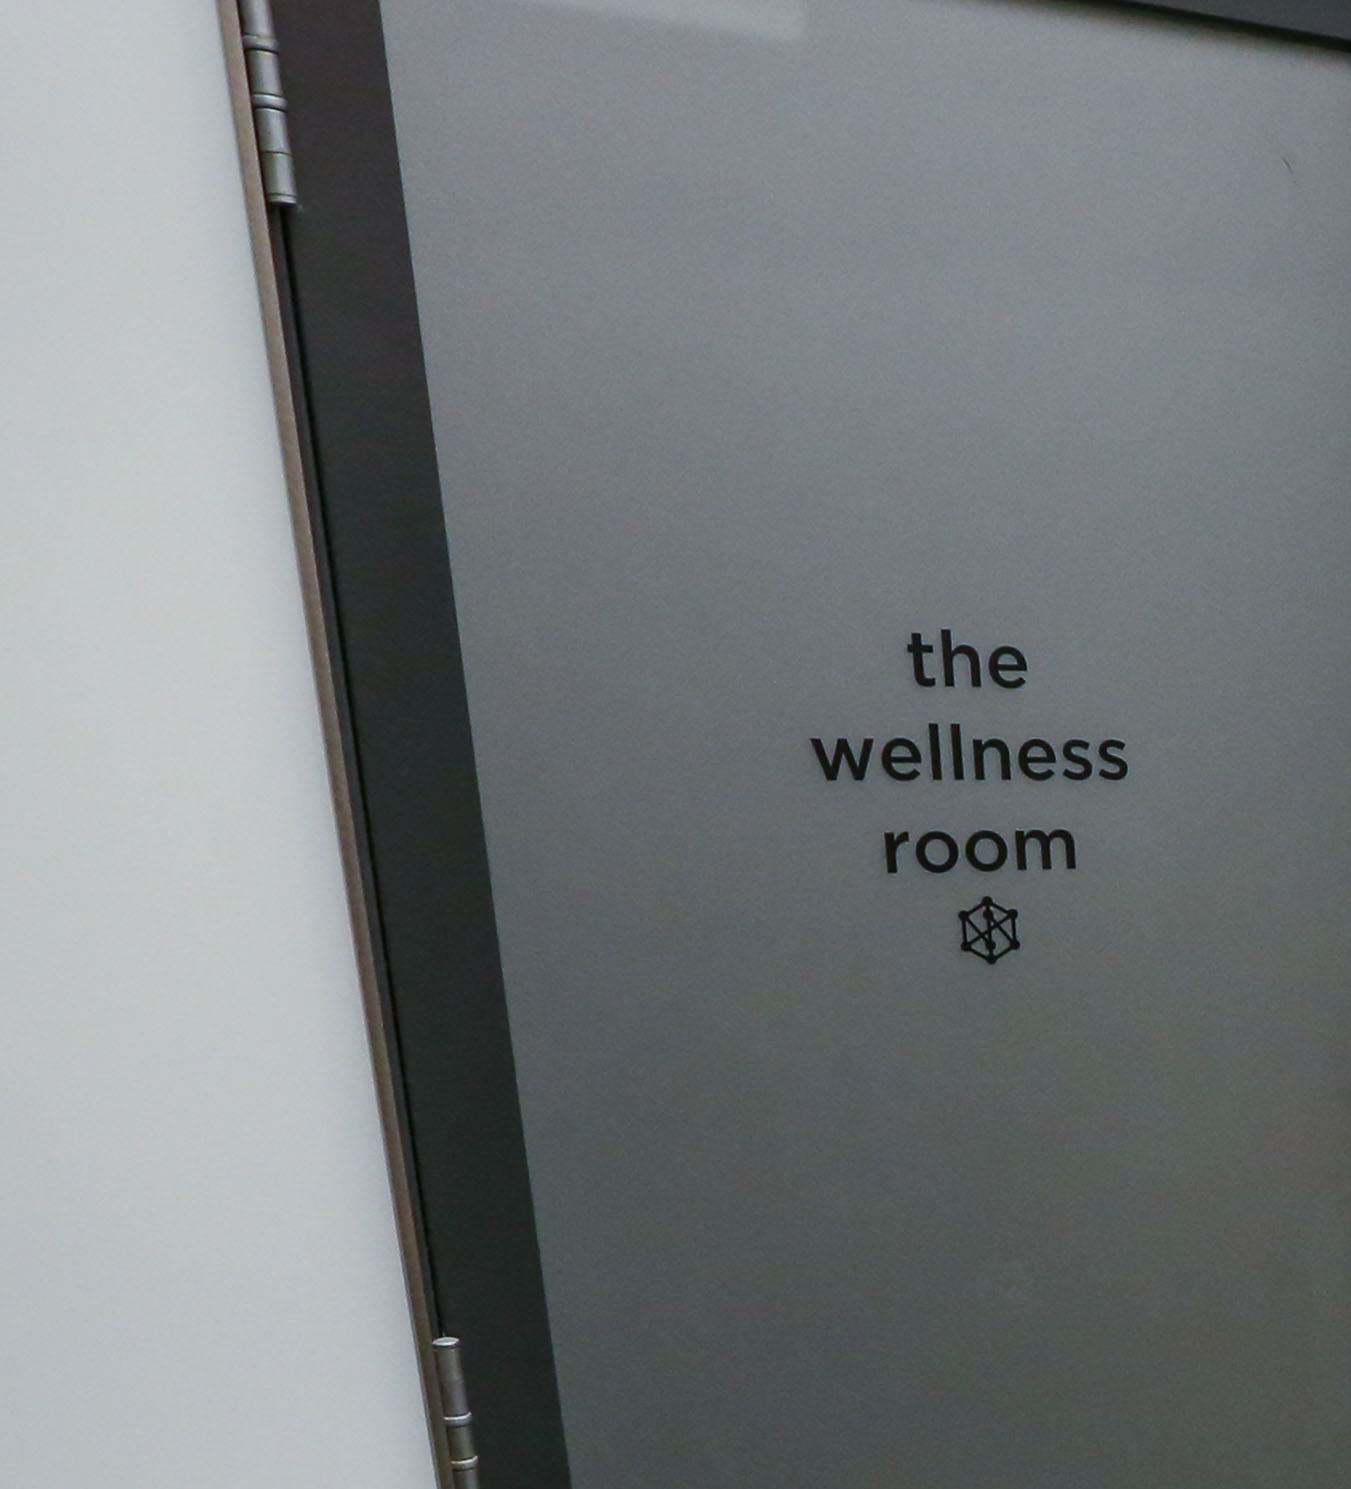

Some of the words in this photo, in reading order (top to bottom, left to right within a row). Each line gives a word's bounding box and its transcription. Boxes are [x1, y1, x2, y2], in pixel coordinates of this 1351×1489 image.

[906, 628, 1029, 690] the
[810, 722, 1129, 782] wellness
[883, 828, 1078, 874] room
